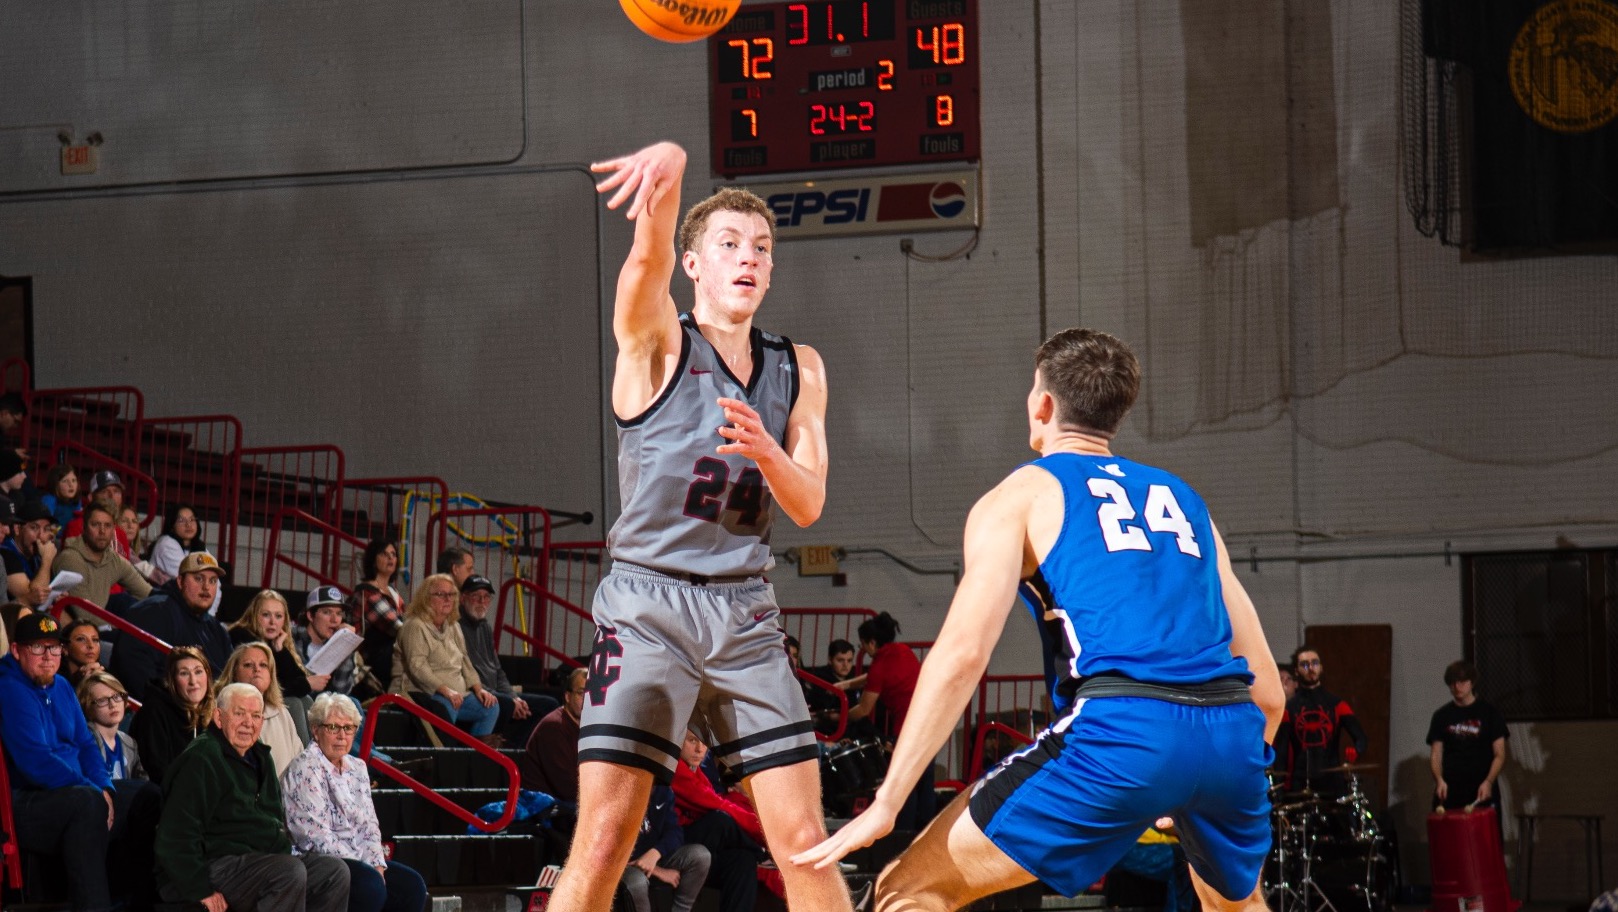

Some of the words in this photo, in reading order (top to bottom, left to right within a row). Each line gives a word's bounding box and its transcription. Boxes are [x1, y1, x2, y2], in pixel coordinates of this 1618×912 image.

[911, 0, 962, 18] Guests
[727, 37, 774, 80] 72
[916, 22, 965, 65] 48
[817, 69, 866, 91] period
[876, 59, 895, 91] 2
[741, 109, 757, 137] 7
[935, 95, 953, 127] 8
[727, 148, 764, 167] fouls
[819, 141, 867, 160] player
[923, 135, 960, 154] fouls
[767, 188, 871, 227] EPSI
[683, 456, 764, 526] 24
[1086, 477, 1202, 559] 24
[808, 546, 831, 565] EXIT
